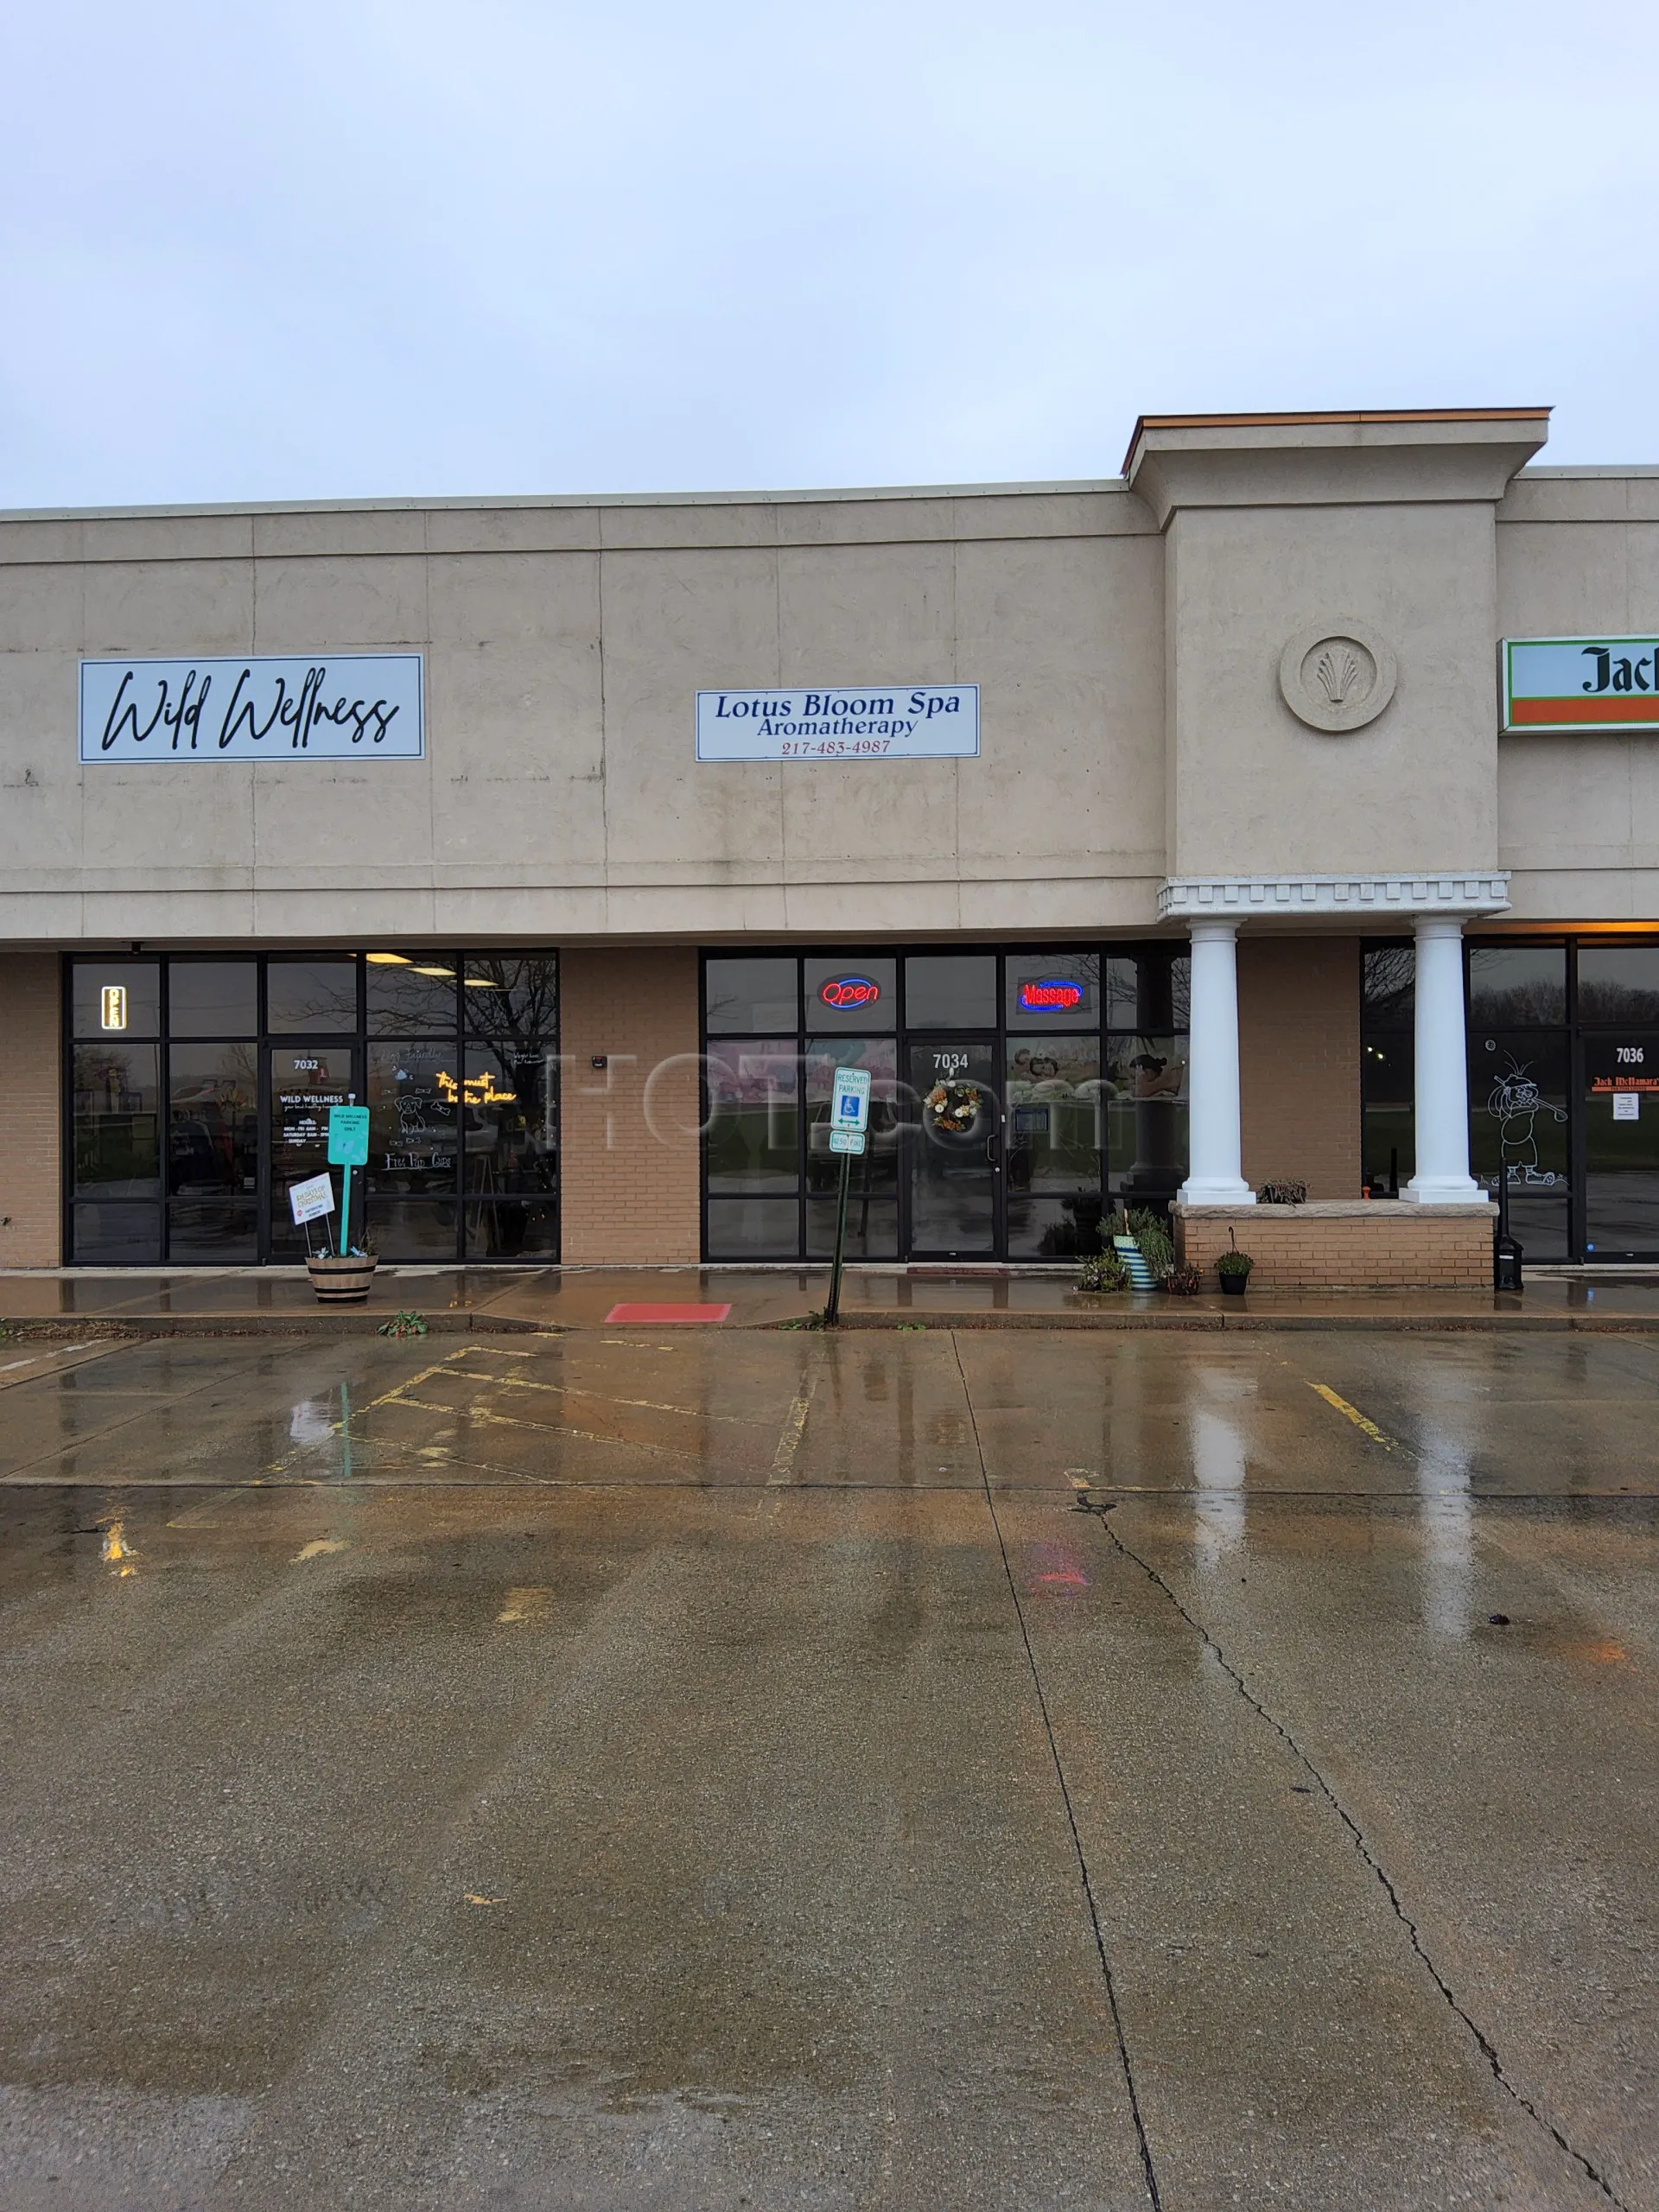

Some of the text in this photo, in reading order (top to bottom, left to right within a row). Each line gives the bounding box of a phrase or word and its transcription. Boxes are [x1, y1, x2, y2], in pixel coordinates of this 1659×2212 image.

[102, 667, 400, 750] Wild Wellness
[715, 691, 960, 719] Lotus Bloom Spa
[757, 716, 918, 737] Aromatherapy
[781, 740, 891, 755] 217-483-4987
[823, 983, 879, 1005] Open
[1024, 984, 1079, 1007] Massage
[932, 1053, 969, 1069] 7034
[1617, 1047, 1644, 1063] 7036
[294, 1060, 318, 1070] 7032
[435, 1071, 496, 1090] this must
[837, 1073, 868, 1084] RESERVED
[1593, 1077, 1612, 1086] Jack
[484, 1085, 517, 1103] place
[839, 1084, 865, 1095] PARKING
